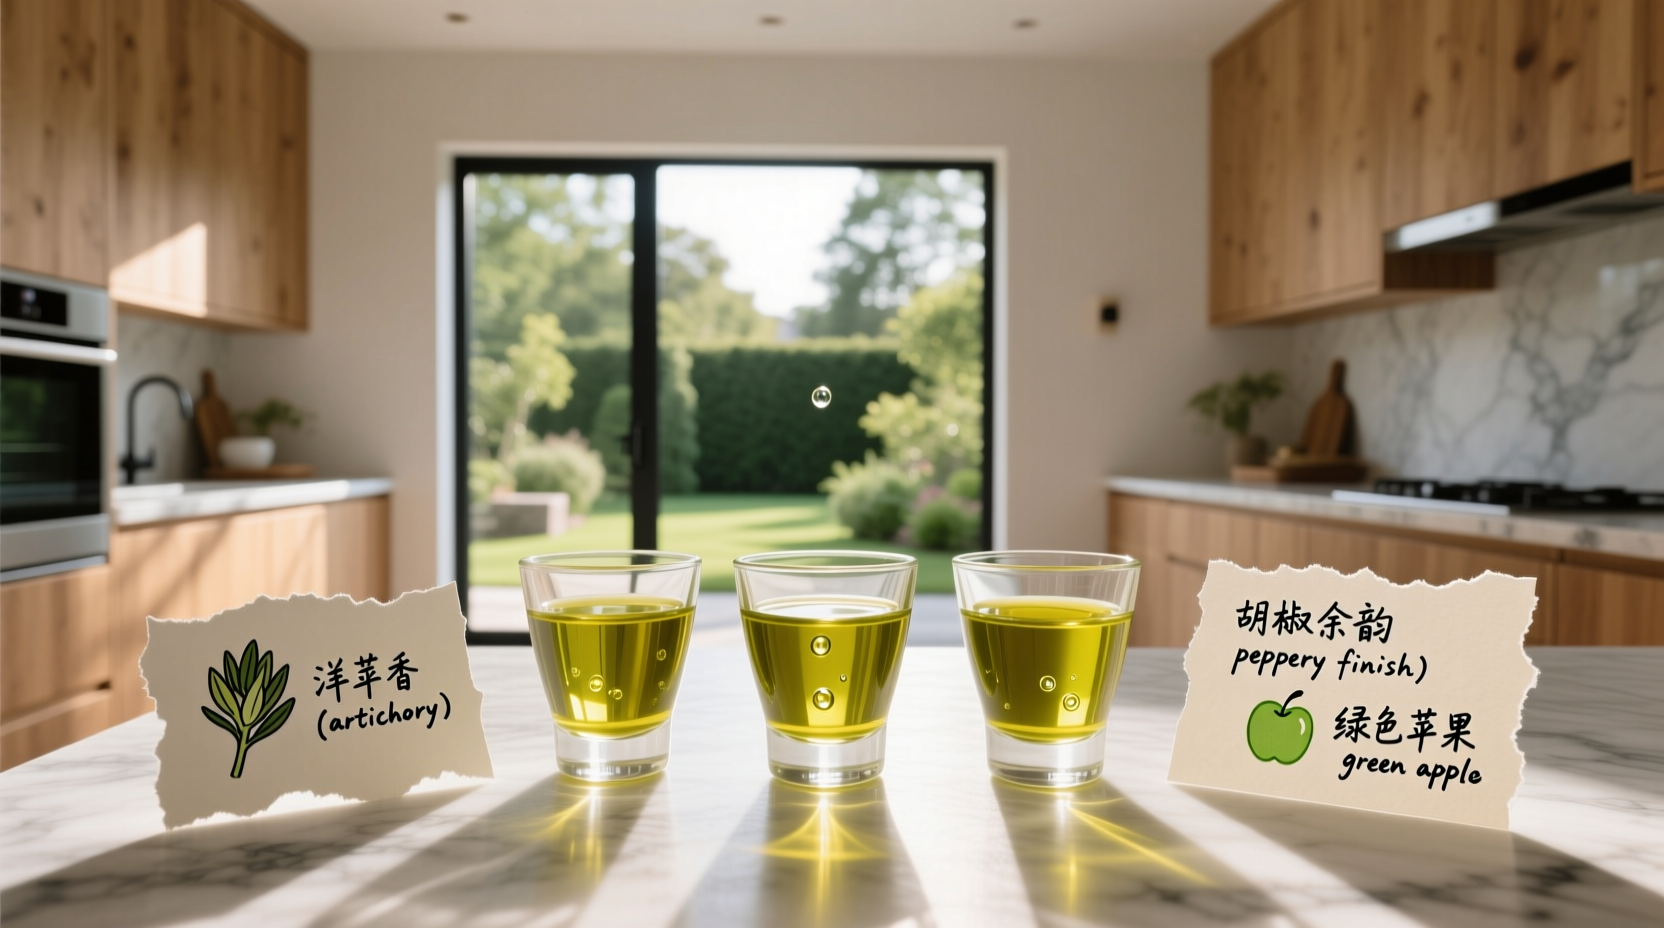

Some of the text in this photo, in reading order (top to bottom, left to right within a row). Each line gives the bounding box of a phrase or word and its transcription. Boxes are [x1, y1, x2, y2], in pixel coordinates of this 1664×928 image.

[1235, 599, 1393, 644] 胡椒余韵
[313, 651, 419, 703] 洋苹香
[1230, 648, 1428, 685] peppery finish)
[317, 692, 452, 741] (artichory)
[1332, 705, 1476, 754] 绿色苹果
[1337, 753, 1483, 792] green apple
